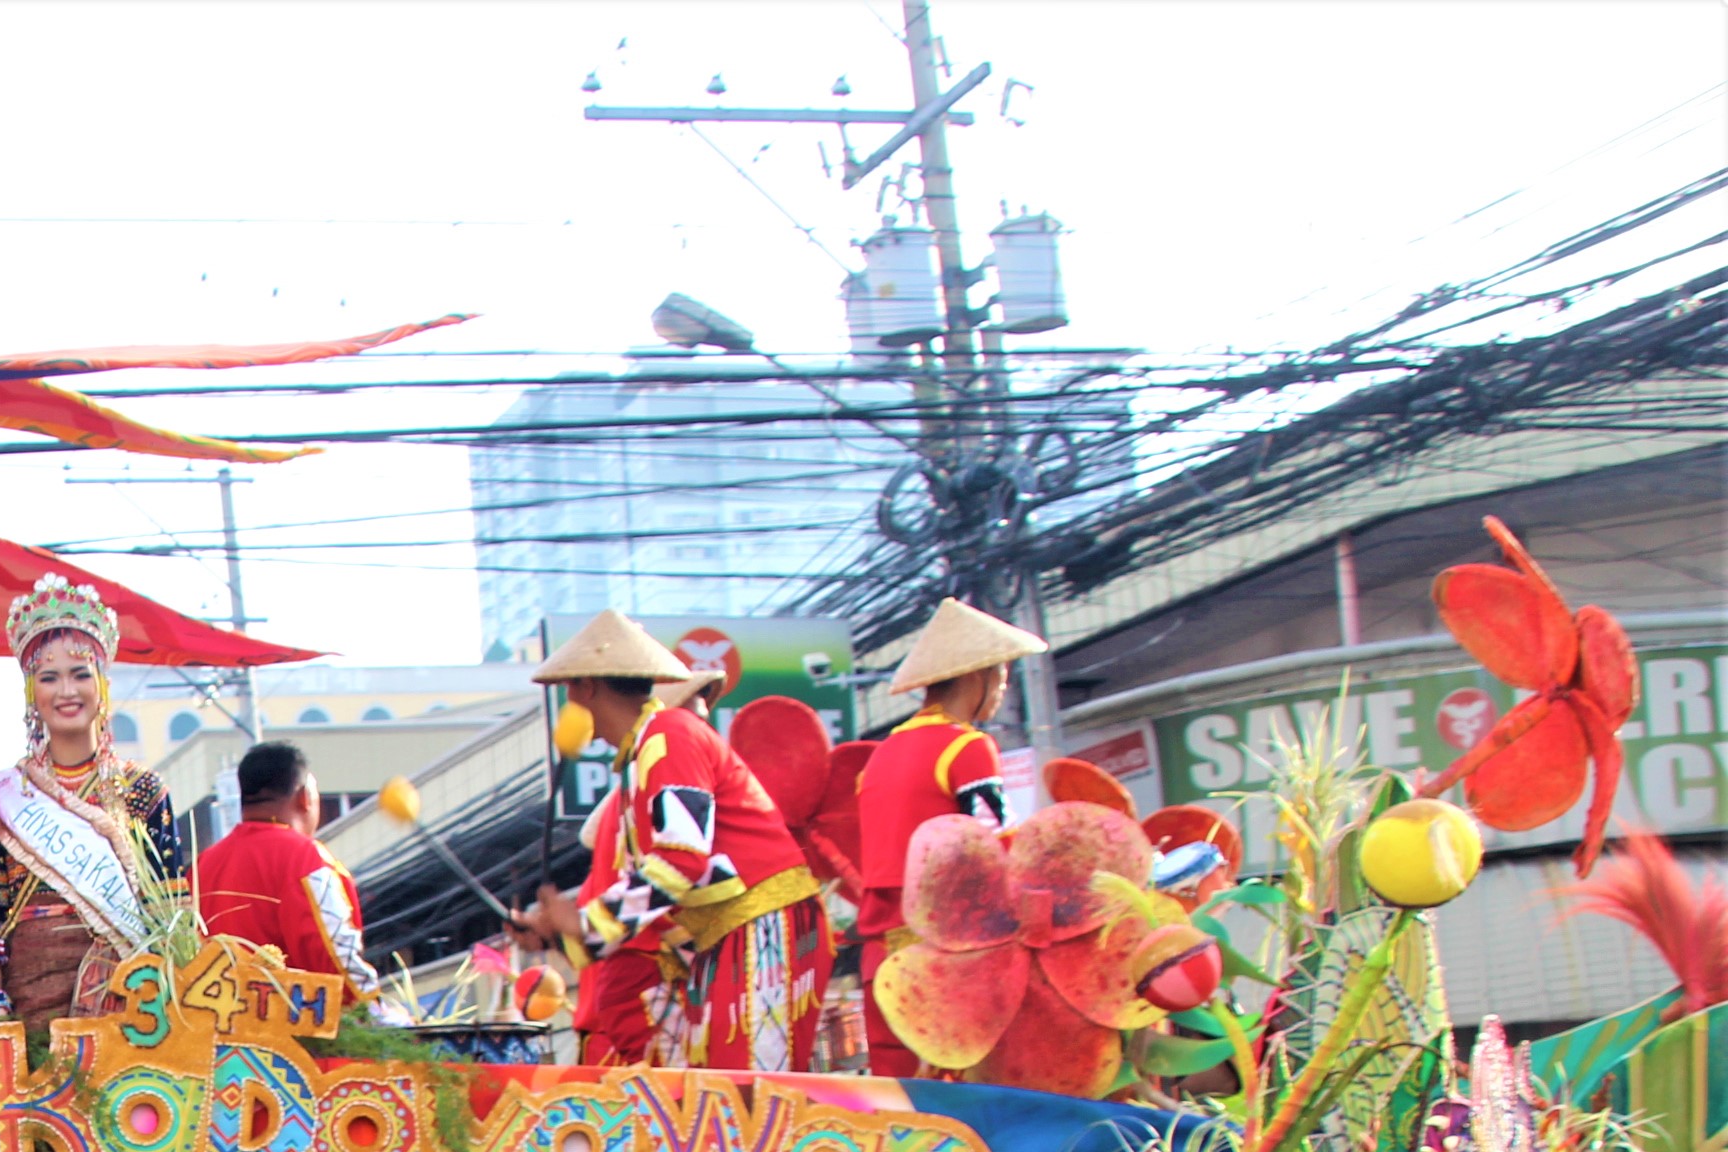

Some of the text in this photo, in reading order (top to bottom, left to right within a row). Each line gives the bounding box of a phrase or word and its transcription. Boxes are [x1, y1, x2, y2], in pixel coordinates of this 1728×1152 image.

[1184, 689, 1421, 789] SAVE
[13, 802, 72, 855] HIYAS
[65, 844, 93, 874] SA
[119, 953, 328, 1047] 34TH
